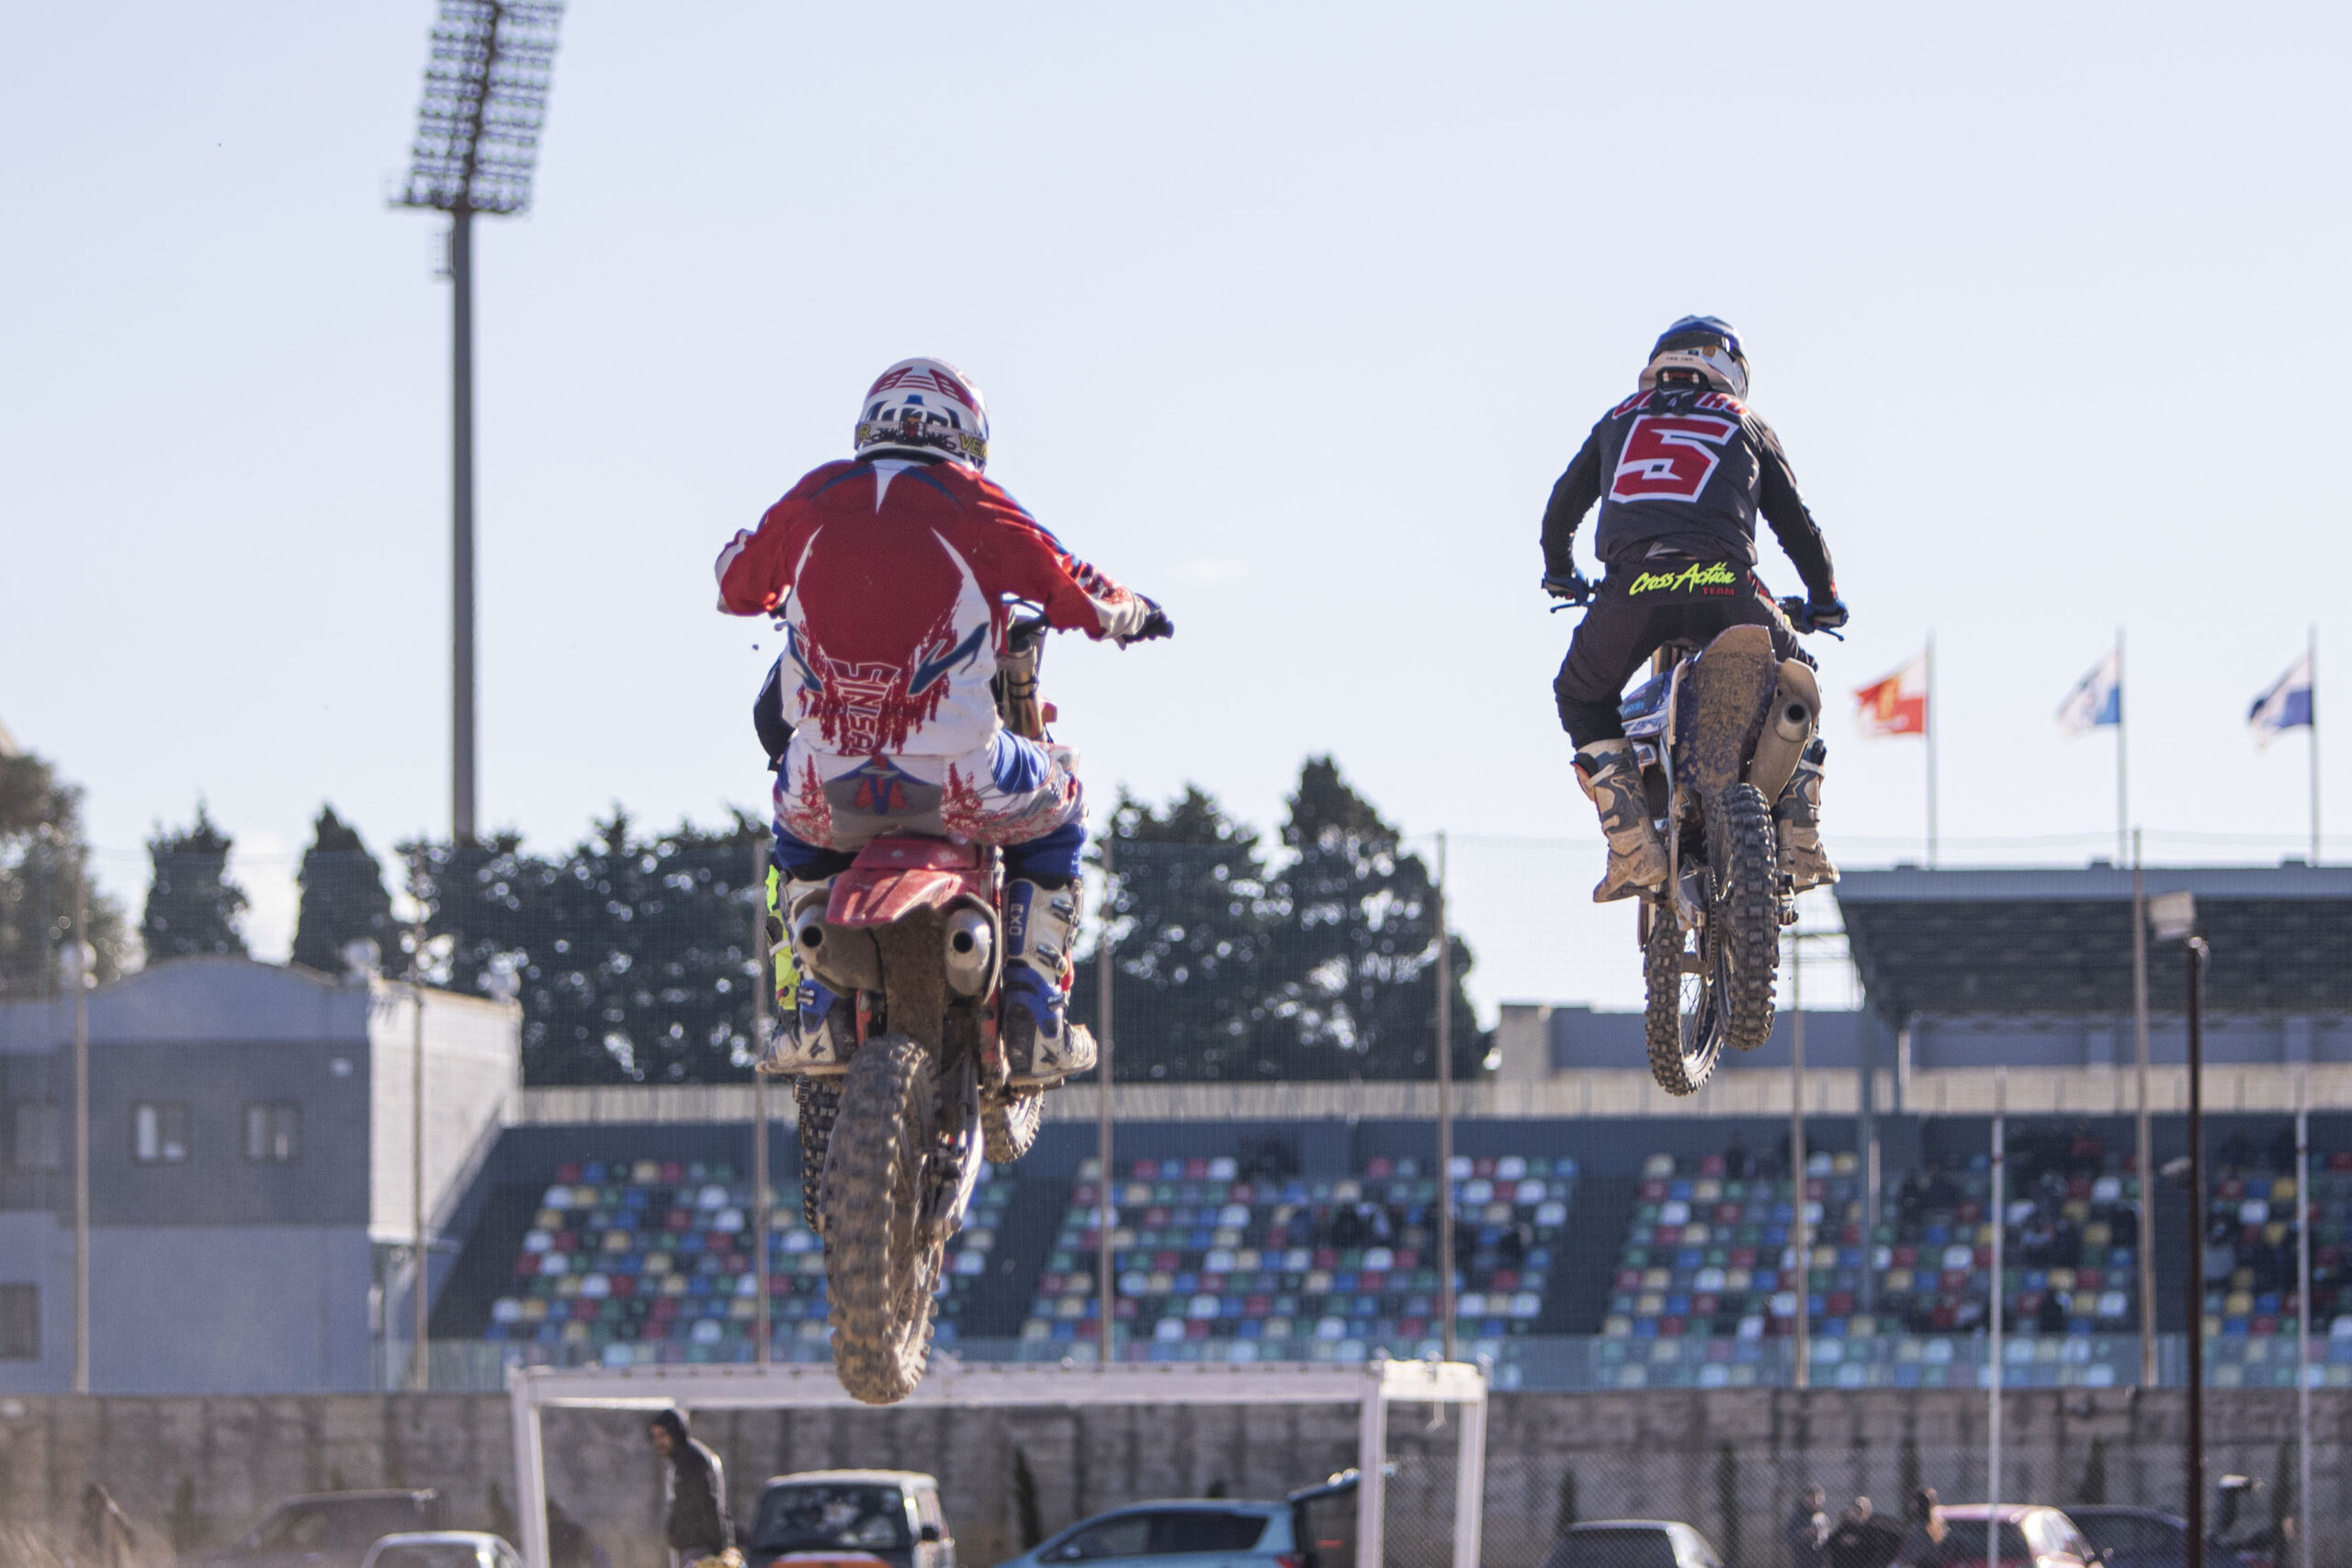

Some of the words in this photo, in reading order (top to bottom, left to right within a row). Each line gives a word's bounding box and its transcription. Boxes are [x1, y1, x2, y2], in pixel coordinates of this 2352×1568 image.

[1609, 413, 1739, 503] 5
[1629, 571, 1676, 595] Cross
[1669, 561, 1736, 593] Action
[1702, 586, 1735, 596] TEAM
